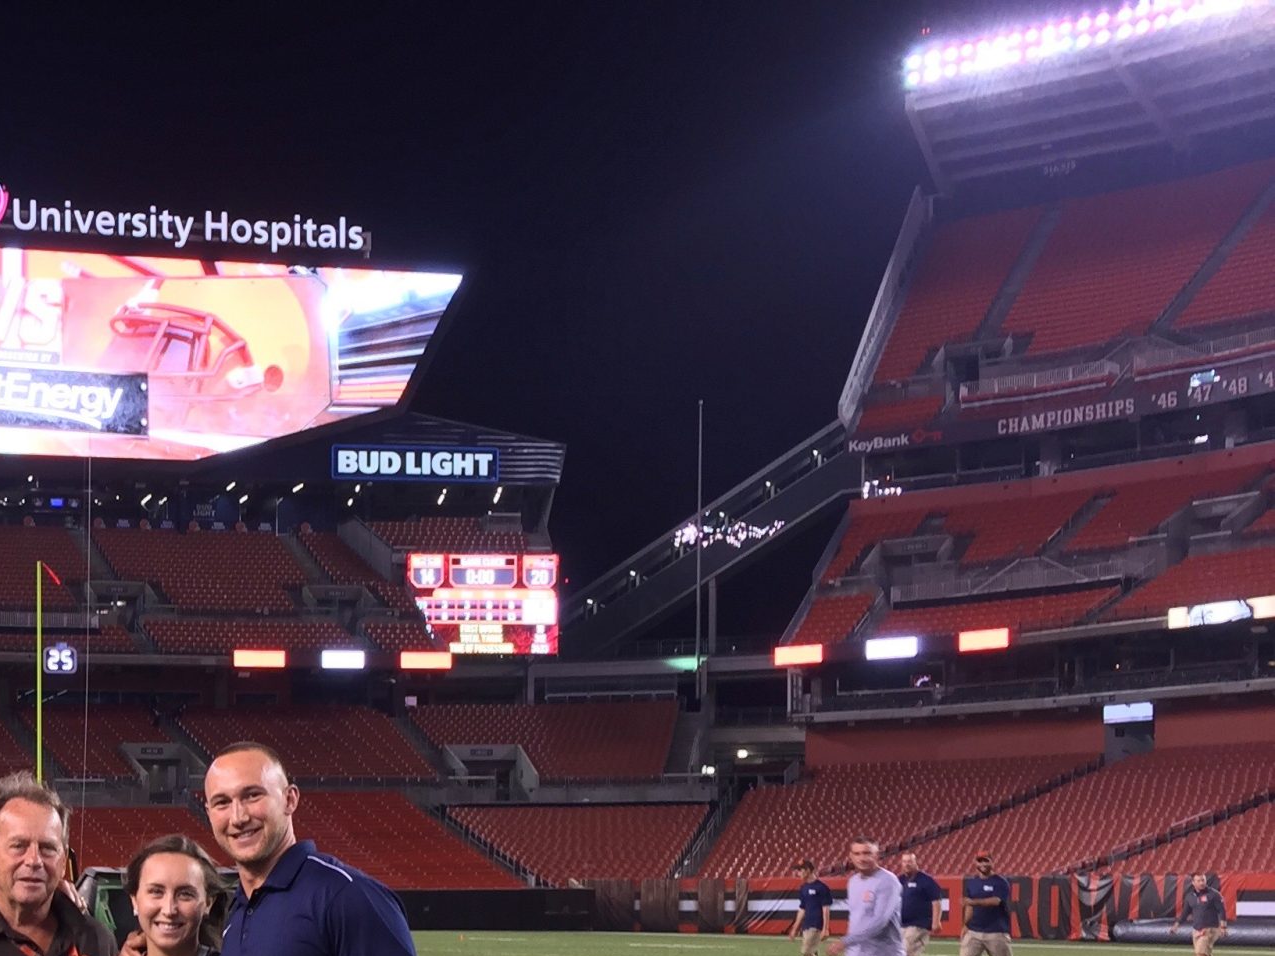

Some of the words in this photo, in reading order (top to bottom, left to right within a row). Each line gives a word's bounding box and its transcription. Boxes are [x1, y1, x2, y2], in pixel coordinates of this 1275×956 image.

[12, 198, 194, 248] University
[204, 210, 365, 252] Hospitals
[997, 398, 1135, 436] CHAMPIONSHIPS
[1151, 390, 1178, 410] '46
[1187, 384, 1214, 404] '47
[1222, 376, 1249, 396] '48
[848, 433, 910, 453] KeyBank
[337, 450, 402, 475] BUD
[405, 451, 494, 477] LIGHT
[419, 568, 436, 585] 14
[465, 568, 496, 586] 0:00
[530, 569, 550, 585] 20
[47, 649, 74, 671] 25
[963, 871, 1220, 941] ROWN
